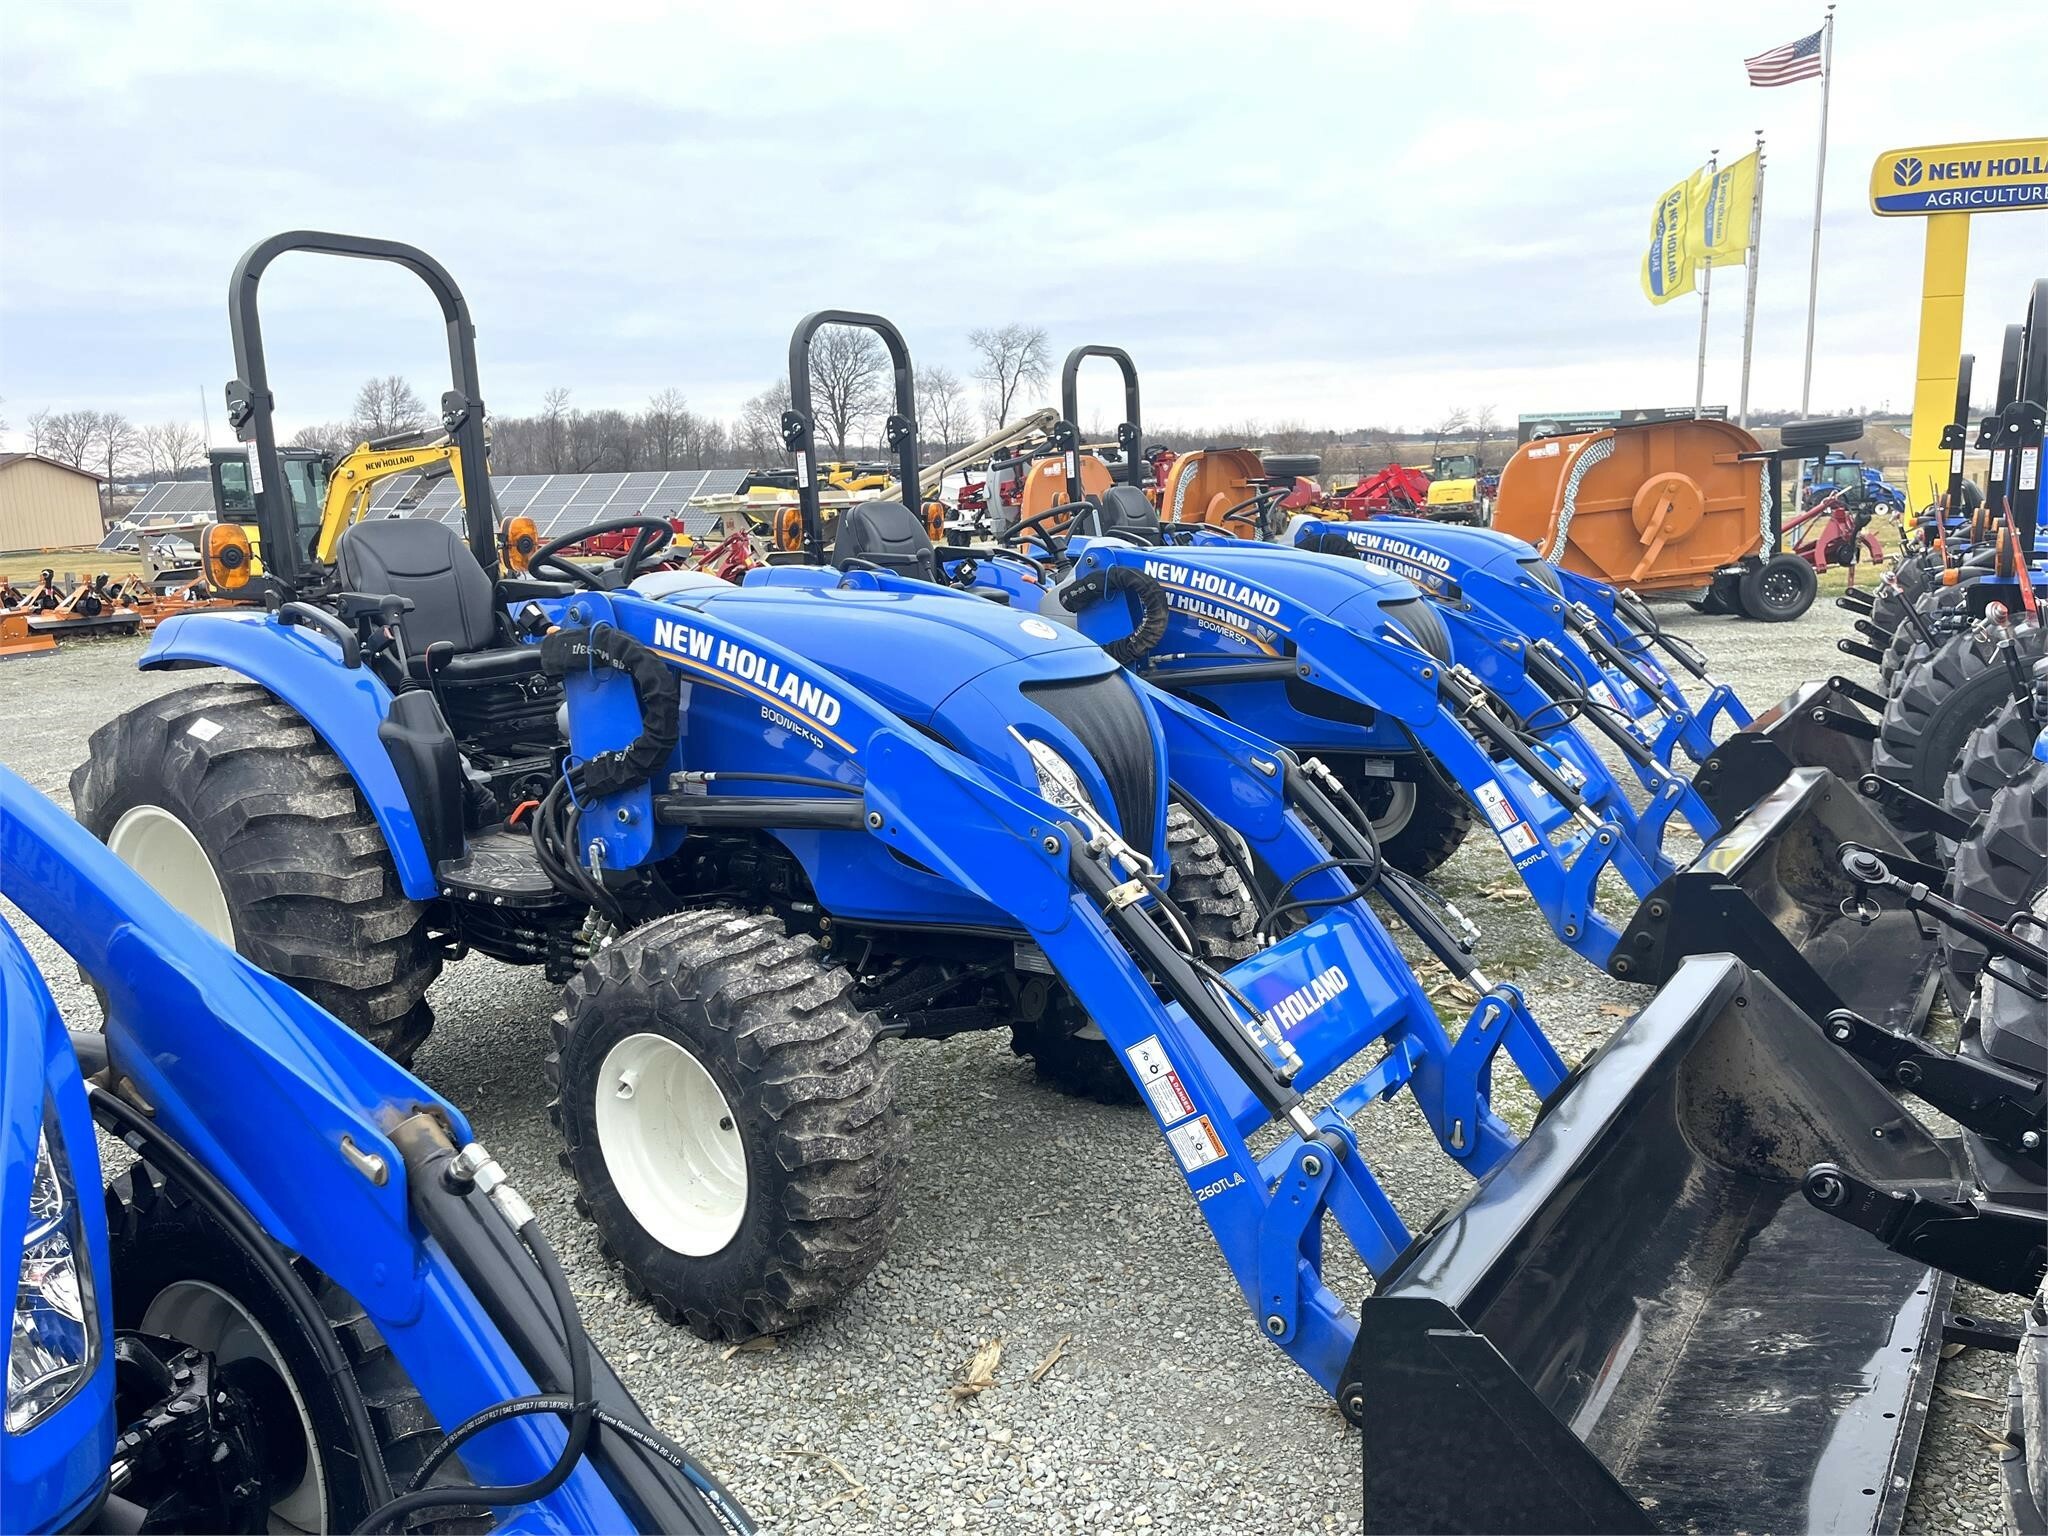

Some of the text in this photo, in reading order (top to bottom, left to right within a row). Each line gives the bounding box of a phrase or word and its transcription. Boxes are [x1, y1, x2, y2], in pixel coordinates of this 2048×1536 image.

[1929, 161, 1982, 181] NEW
[365, 455, 415, 471] NEW HOLLAND
[1347, 531, 1451, 572] NEW HOLLAND
[1144, 560, 1280, 617] NEW HOLLAND
[654, 618, 714, 661] NEW
[716, 640, 841, 727] HOLLAND
[1516, 849, 1549, 871] 260TLA
[1272, 965, 1349, 1031] HOLLAND
[1173, 1081, 1193, 1111] DANGER
[1195, 1171, 1246, 1201] 260TLA
[597, 1411, 682, 1466] Flame Resistant MSHA 20-11C
